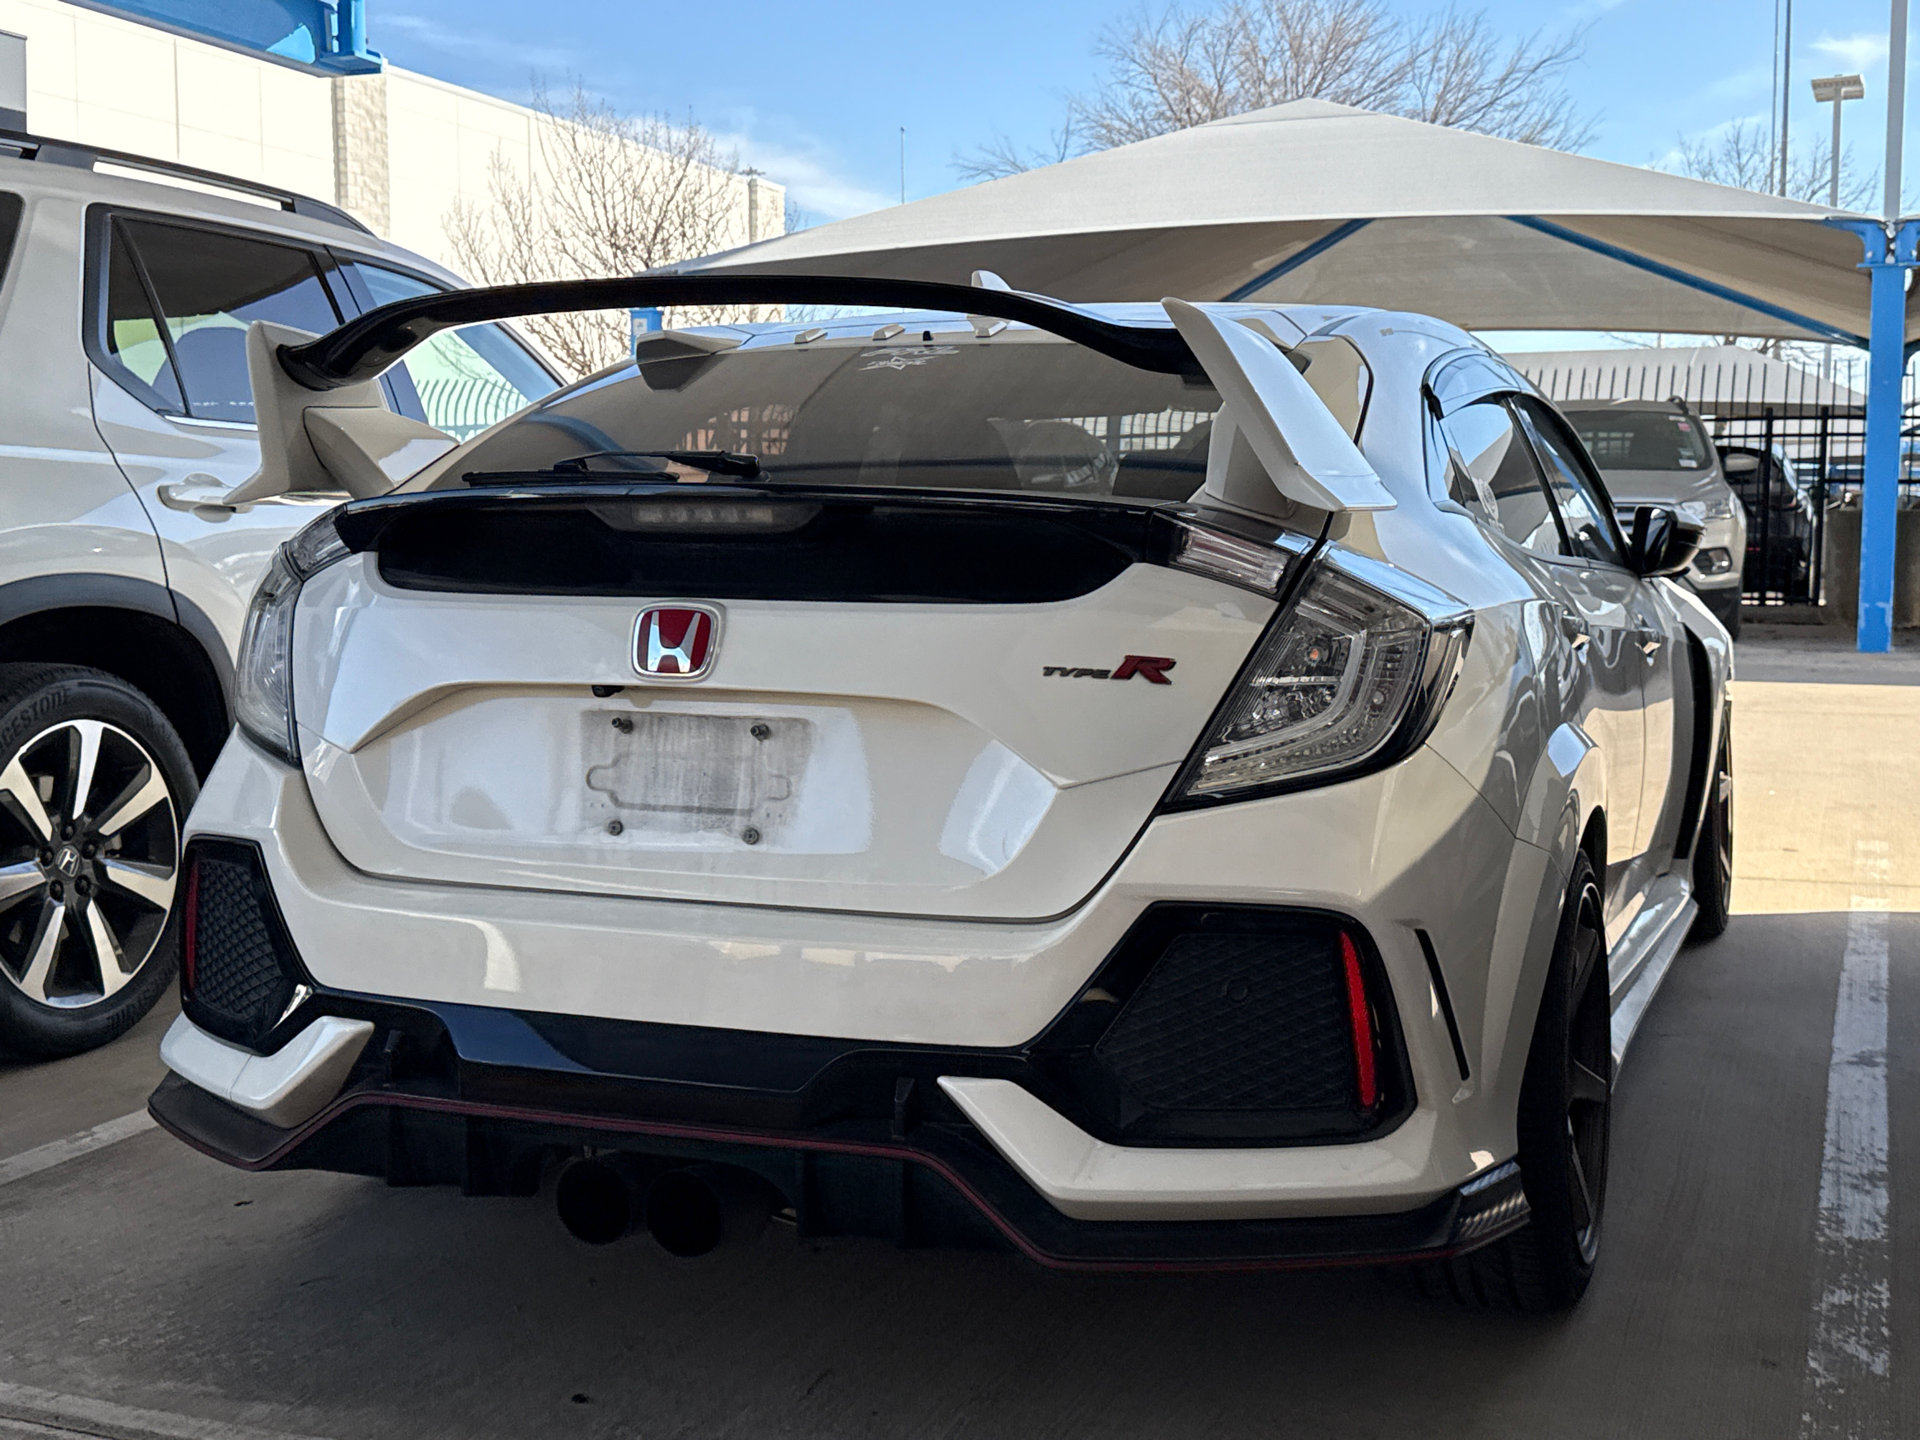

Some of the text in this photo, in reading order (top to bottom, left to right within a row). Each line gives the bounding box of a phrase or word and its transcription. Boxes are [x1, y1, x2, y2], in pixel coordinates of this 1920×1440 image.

[1042, 654, 1177, 686] TYPE R
[0, 687, 71, 752] GESTONE
